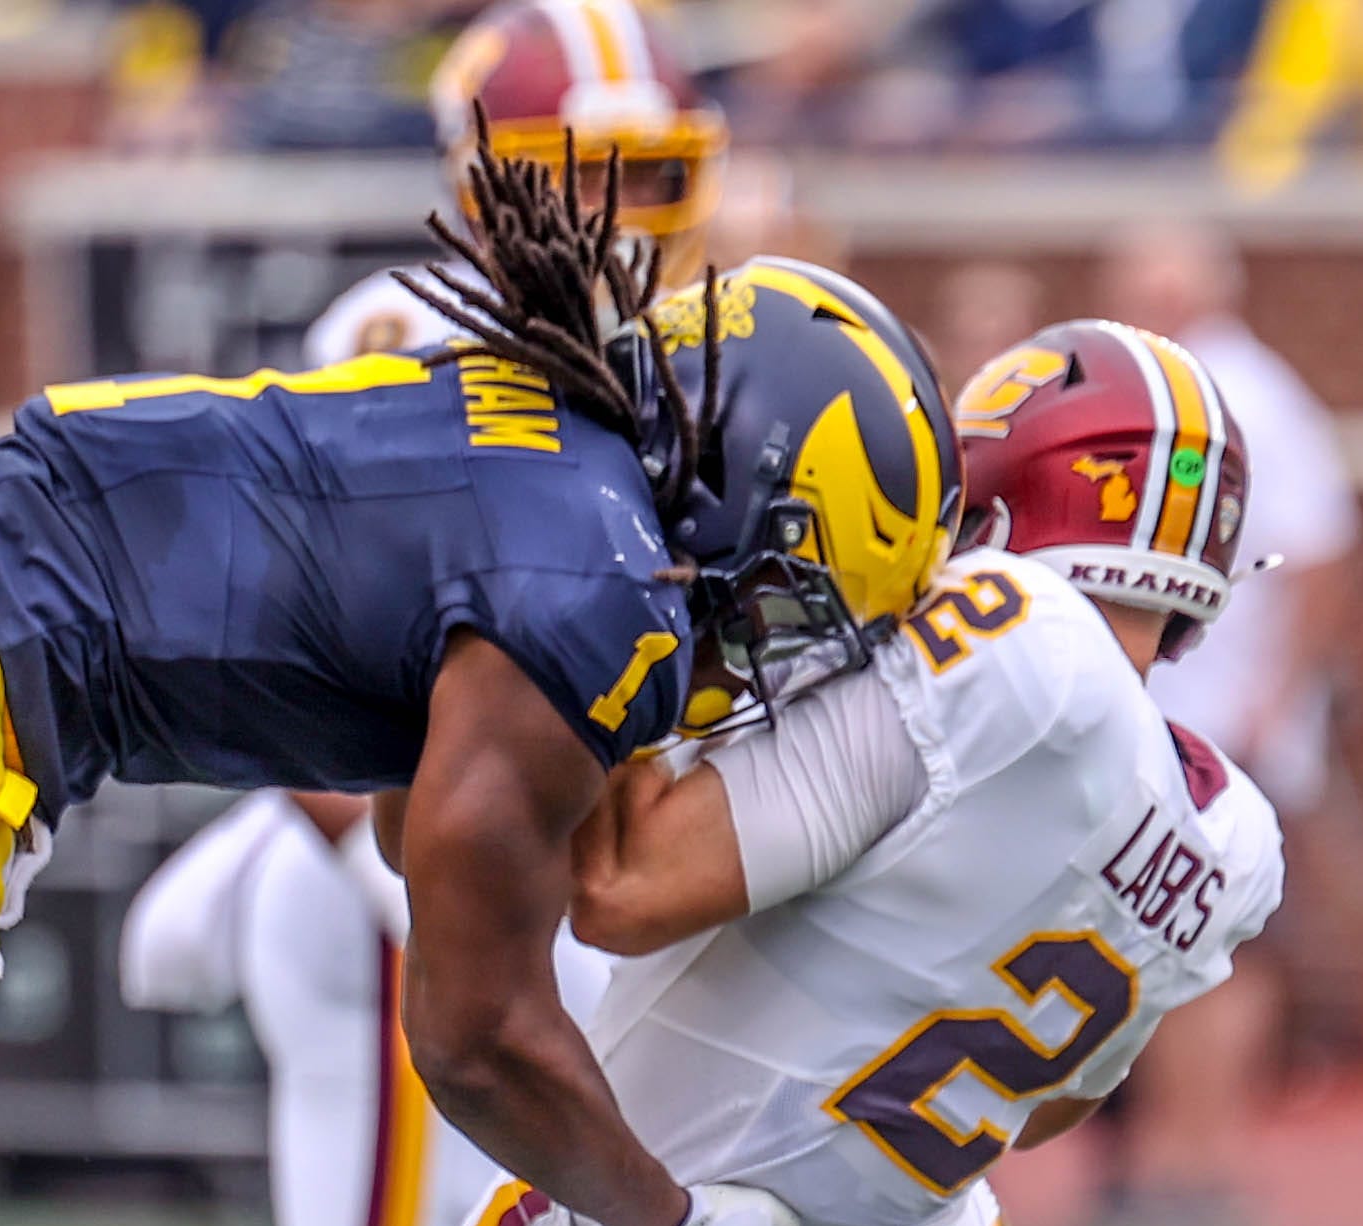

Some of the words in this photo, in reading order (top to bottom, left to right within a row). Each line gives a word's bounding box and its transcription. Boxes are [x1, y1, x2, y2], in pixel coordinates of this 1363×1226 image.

[446, 337, 562, 453] HAM
[901, 569, 1033, 677] 2
[1068, 562, 1222, 609] KRAMER
[587, 630, 679, 733] 1
[1100, 803, 1226, 954] LABS
[820, 929, 1140, 1197] 2
